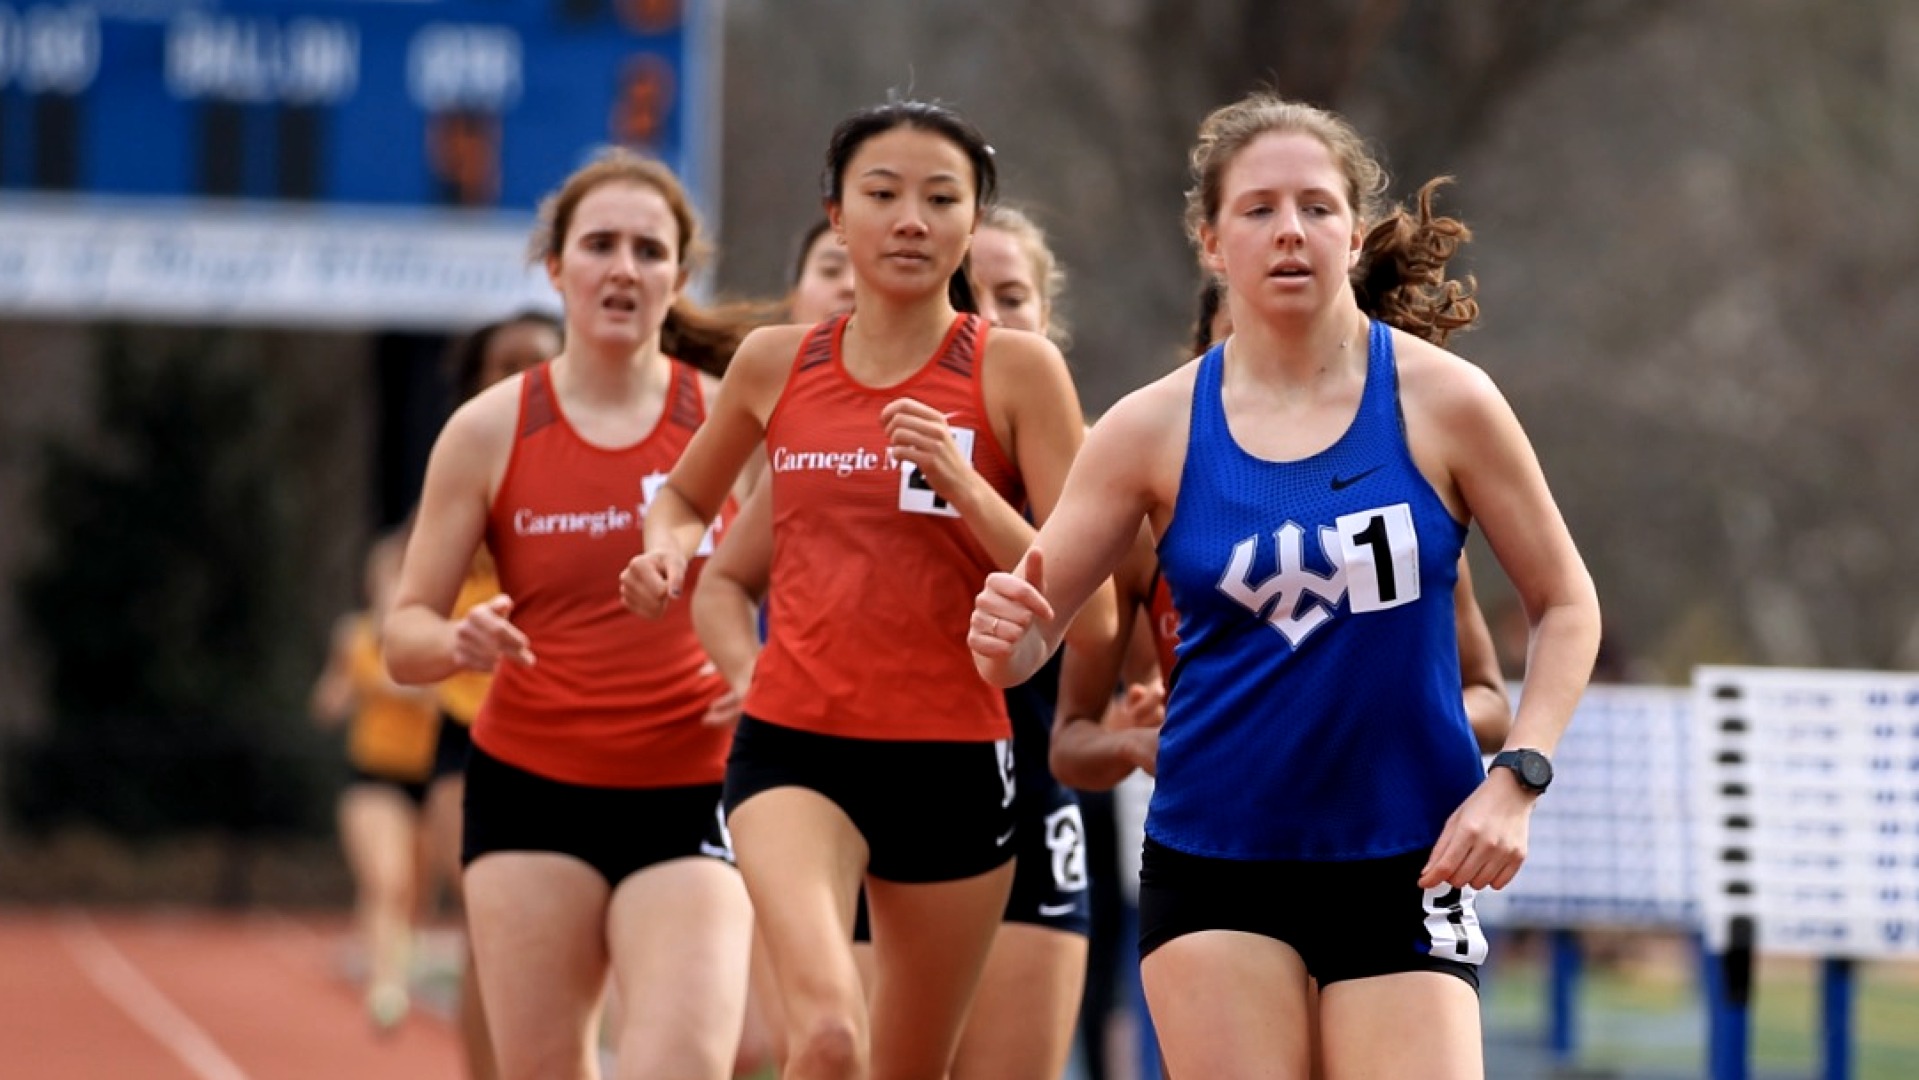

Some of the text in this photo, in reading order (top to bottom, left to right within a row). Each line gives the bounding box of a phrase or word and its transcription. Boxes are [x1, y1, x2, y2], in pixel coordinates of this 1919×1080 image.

[774, 447, 878, 476] Carnegie
[514, 505, 632, 538] Carnegie
[1353, 515, 1397, 602] 1
[1055, 816, 1081, 881] 2
